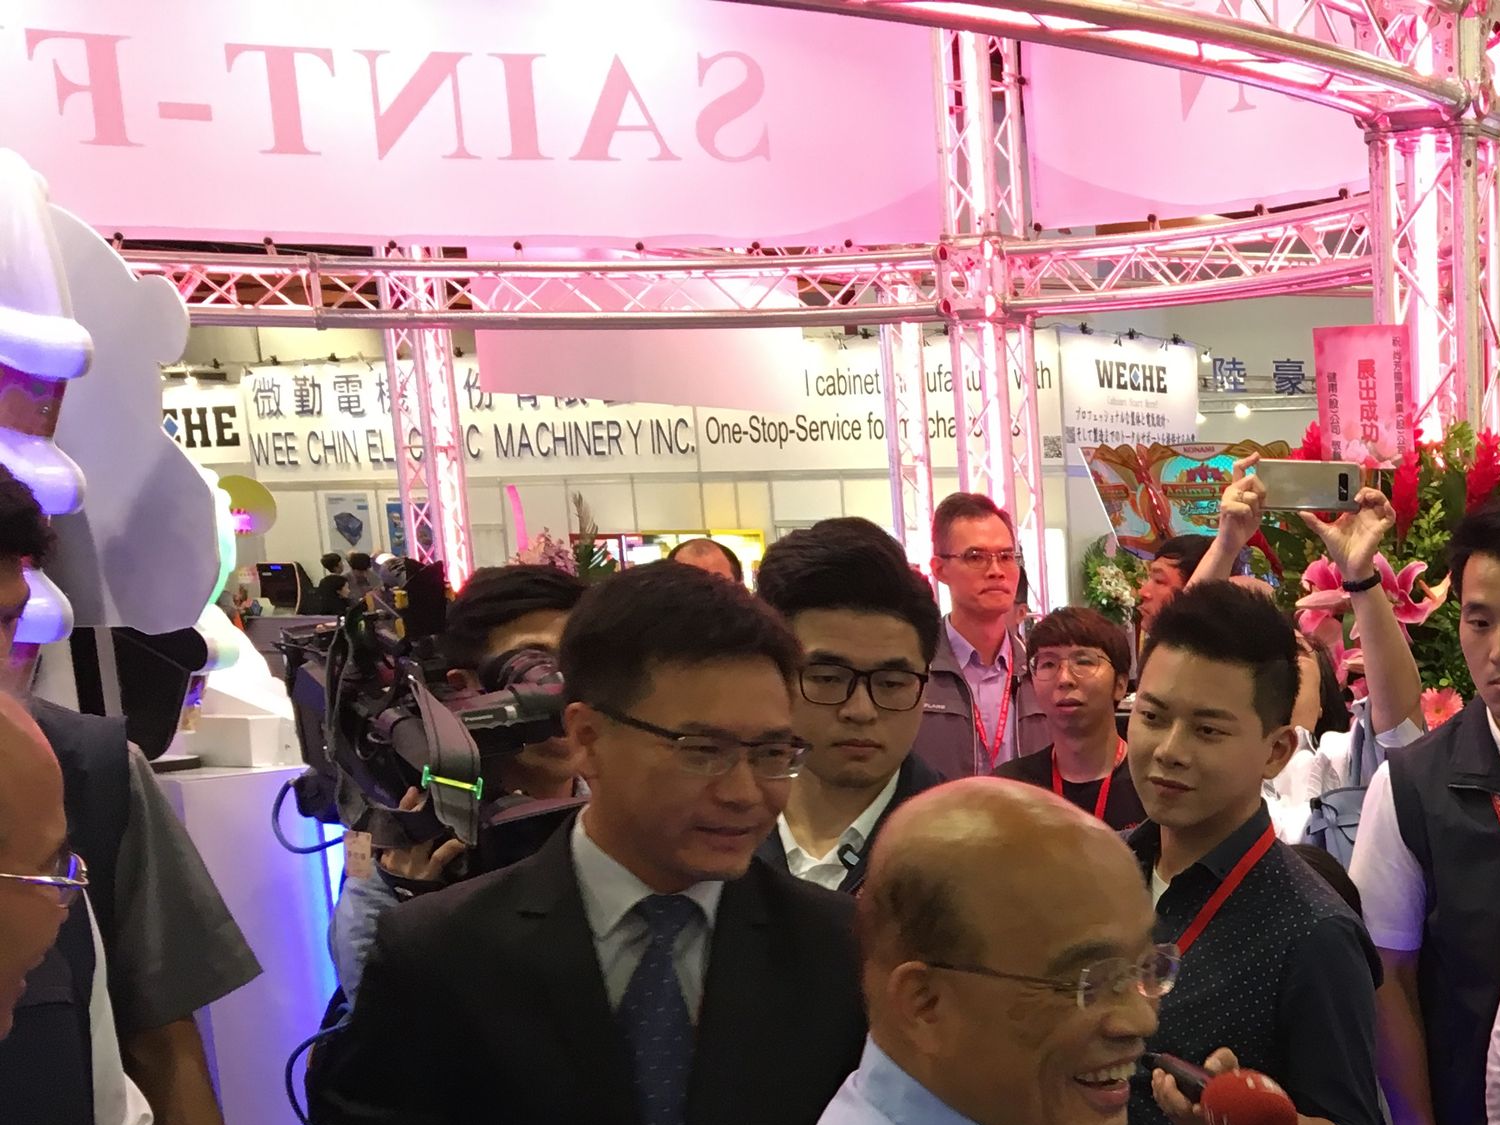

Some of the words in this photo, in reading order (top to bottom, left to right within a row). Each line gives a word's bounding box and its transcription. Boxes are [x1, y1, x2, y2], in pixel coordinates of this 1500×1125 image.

[815, 367, 881, 397] cabinet
[1357, 358, 1379, 443] 展出成功
[250, 431, 300, 466] WEE
[307, 429, 359, 466] CHIN
[493, 419, 642, 458] MACHINERY
[649, 417, 696, 456] INC.
[705, 411, 862, 448] One-Stop-Service
[867, 411, 890, 440] fo
